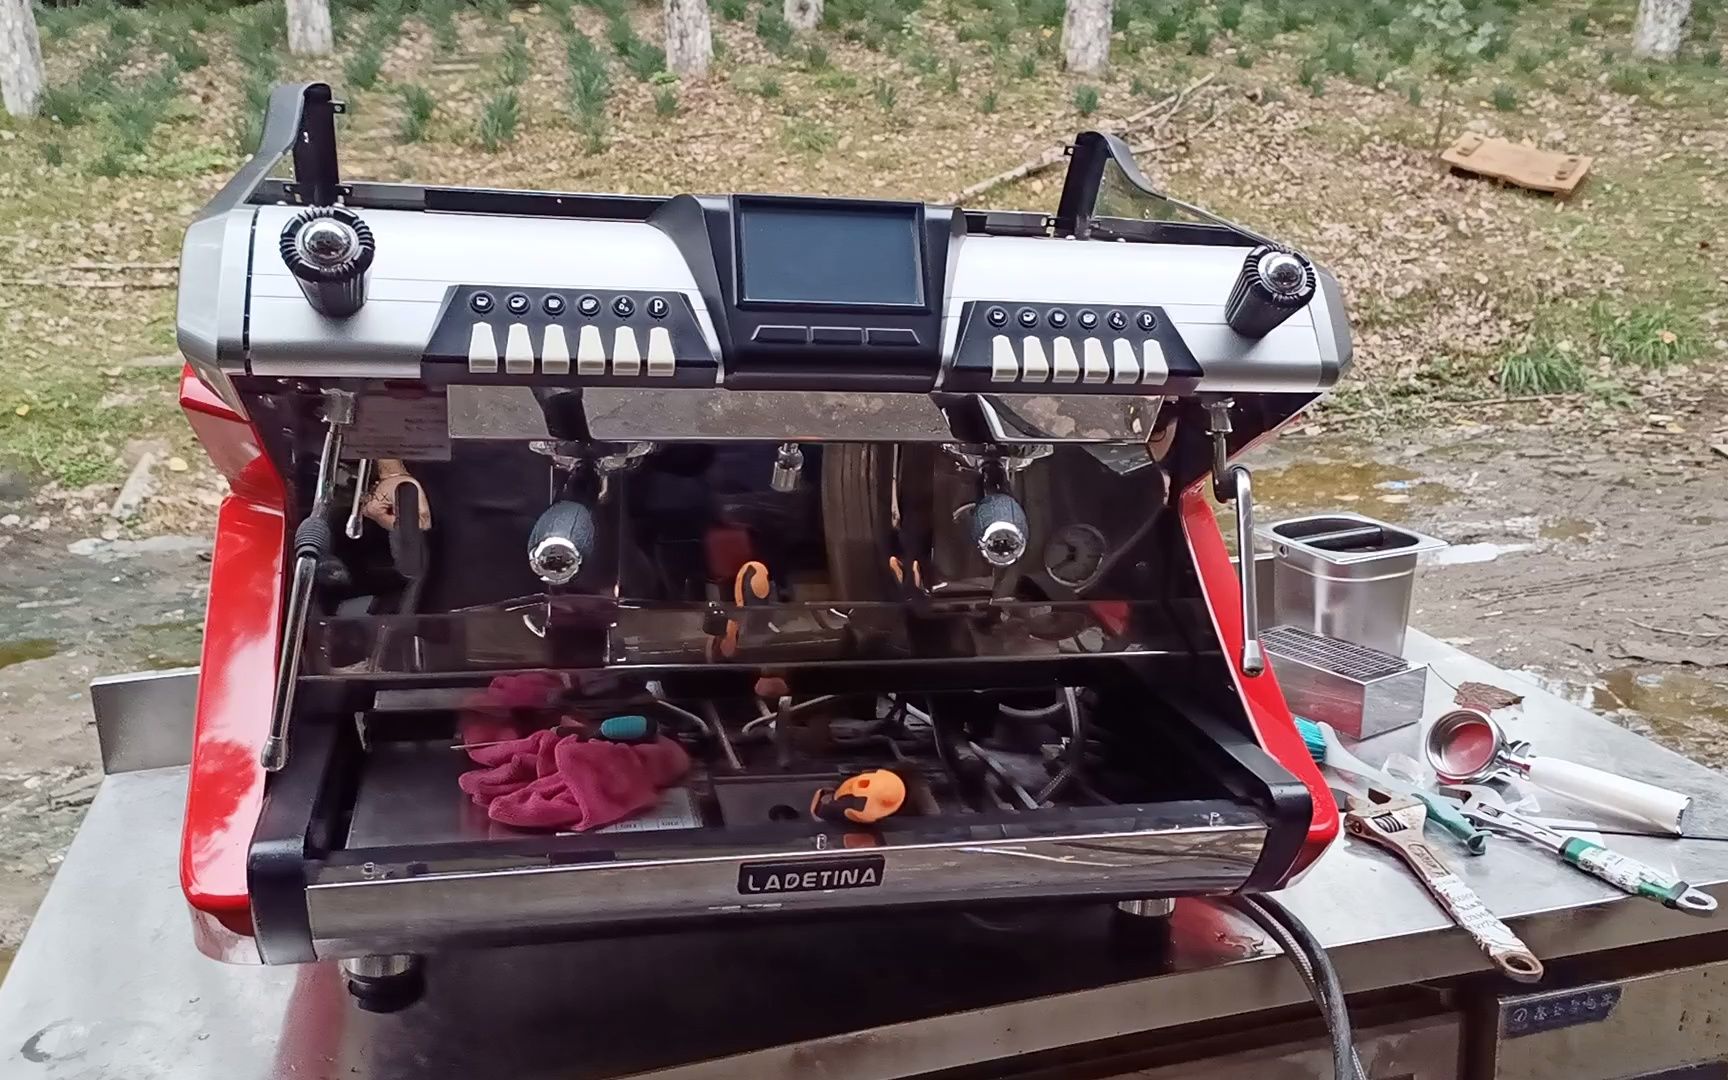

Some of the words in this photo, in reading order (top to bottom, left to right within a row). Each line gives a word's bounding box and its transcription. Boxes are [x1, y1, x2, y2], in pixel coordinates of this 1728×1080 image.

[653, 299, 664, 313] P
[1143, 314, 1153, 326] P
[748, 867, 877, 892] LADETINA
